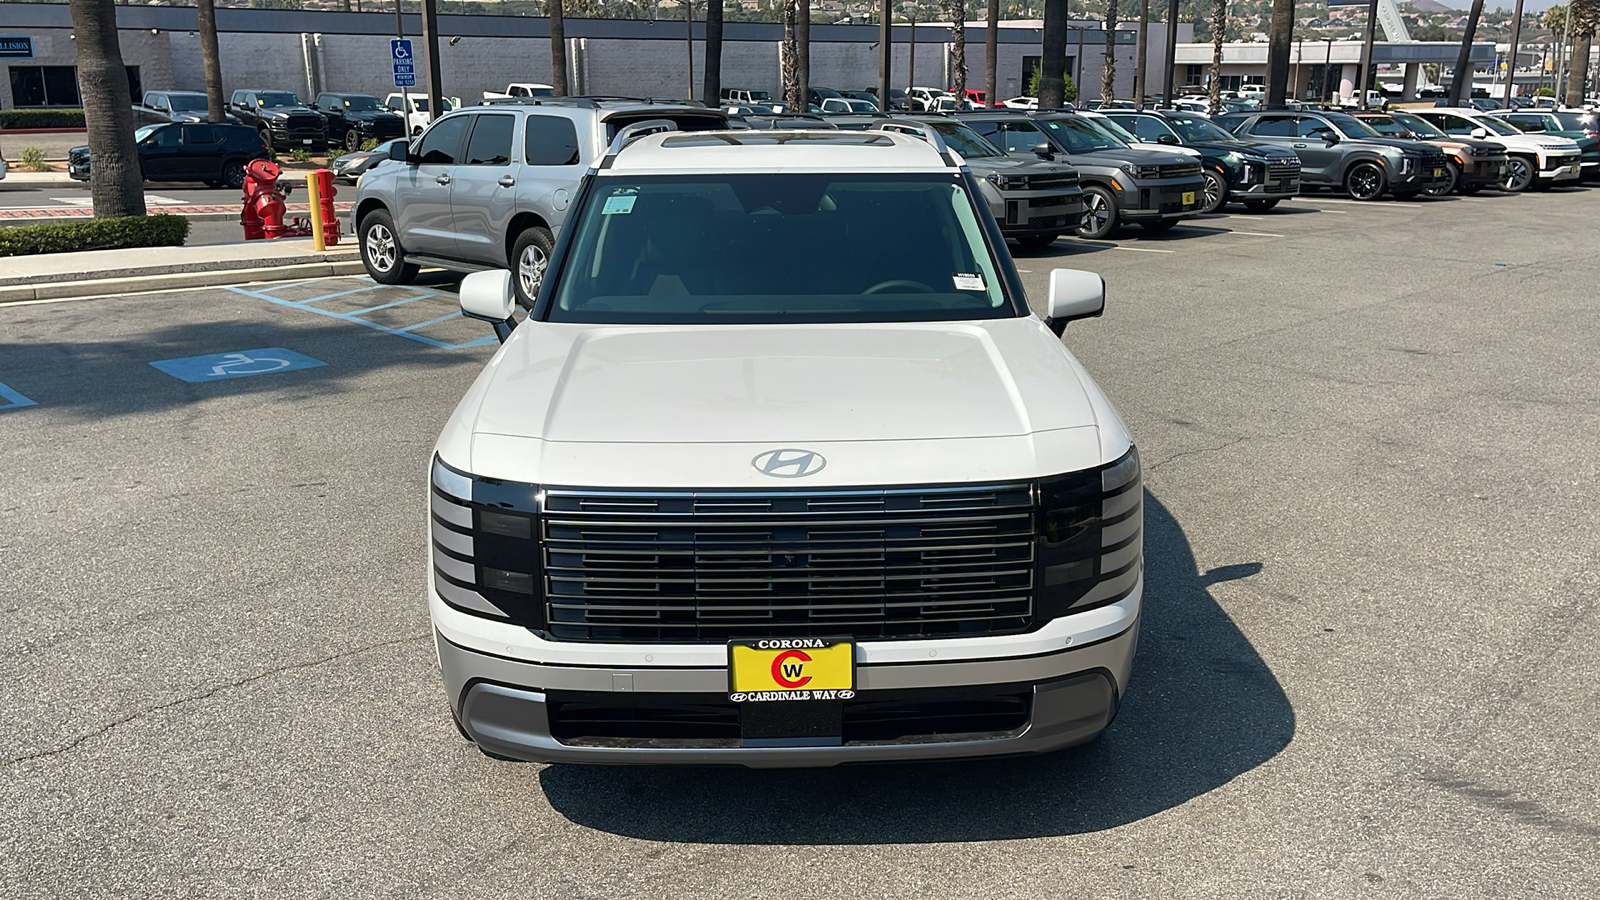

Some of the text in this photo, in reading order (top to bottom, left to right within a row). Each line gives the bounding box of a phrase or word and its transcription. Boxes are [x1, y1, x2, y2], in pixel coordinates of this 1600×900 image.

[758, 639, 825, 649] CORONA
[748, 690, 838, 702] CARDINALE WAY
